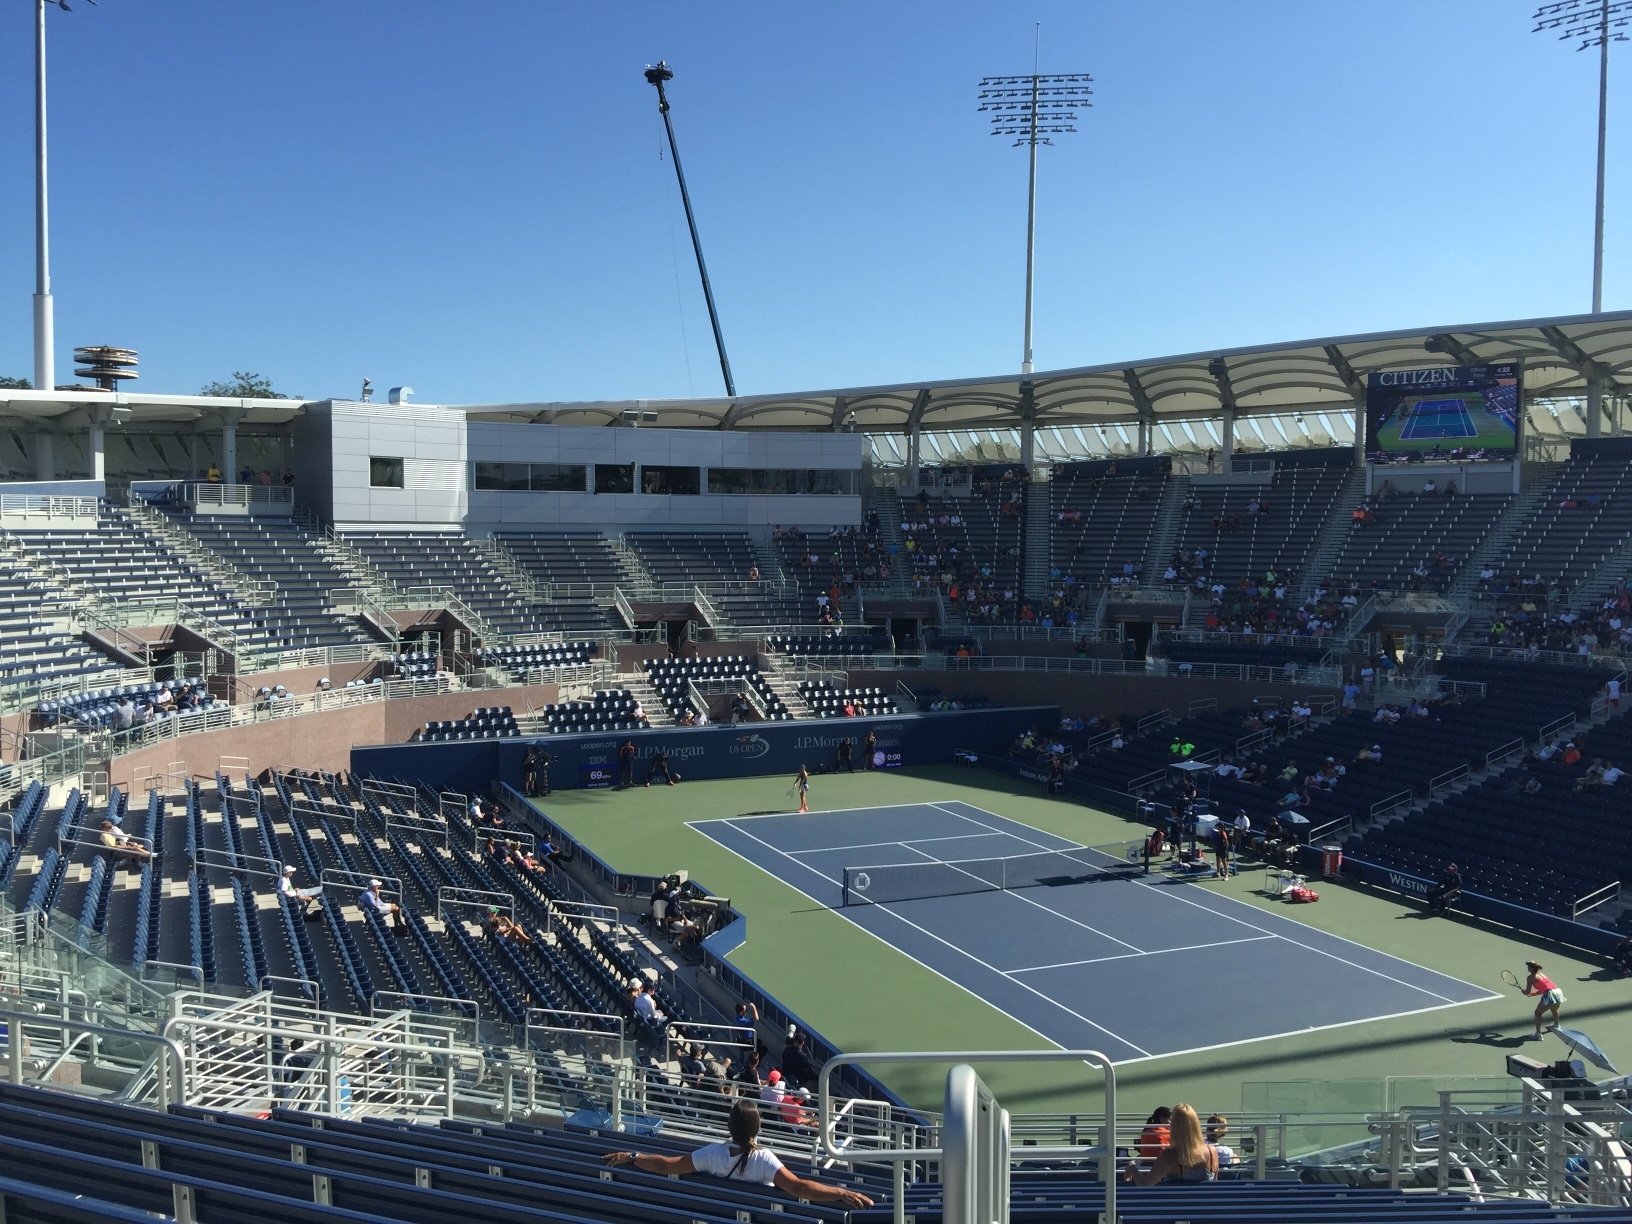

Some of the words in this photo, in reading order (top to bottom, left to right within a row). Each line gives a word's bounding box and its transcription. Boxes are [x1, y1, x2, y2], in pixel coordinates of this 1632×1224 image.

[1380, 368, 1456, 386] CITIZEN
[873, 723, 903, 731] usopen.org
[580, 741, 617, 750] usopen.org
[794, 735, 858, 750] J.P.Morgn
[729, 745, 740, 754] US
[740, 743, 764, 753] OPEN
[589, 755, 607, 765] IBM
[887, 753, 901, 761] 0:00
[590, 770, 603, 780] 69
[1388, 872, 1428, 894] WESTIN
